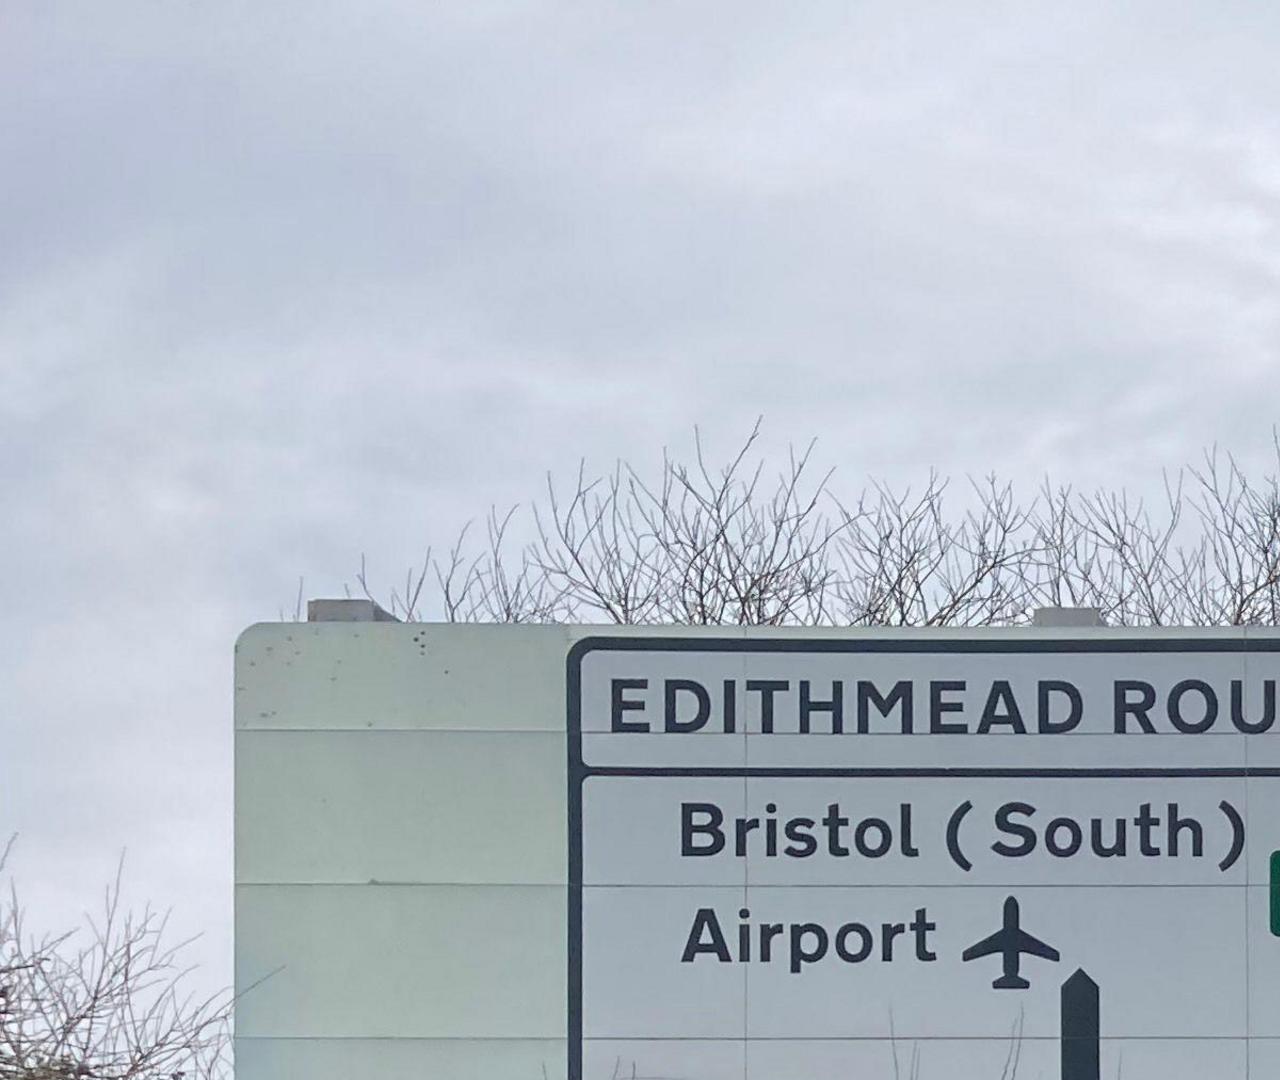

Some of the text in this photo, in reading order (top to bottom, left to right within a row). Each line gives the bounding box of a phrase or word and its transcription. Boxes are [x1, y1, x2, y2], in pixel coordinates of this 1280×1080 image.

[610, 678, 1084, 736] EDITHMEAD
[680, 799, 1246, 872] Bristol (South)
[681, 907, 938, 974] Airport
